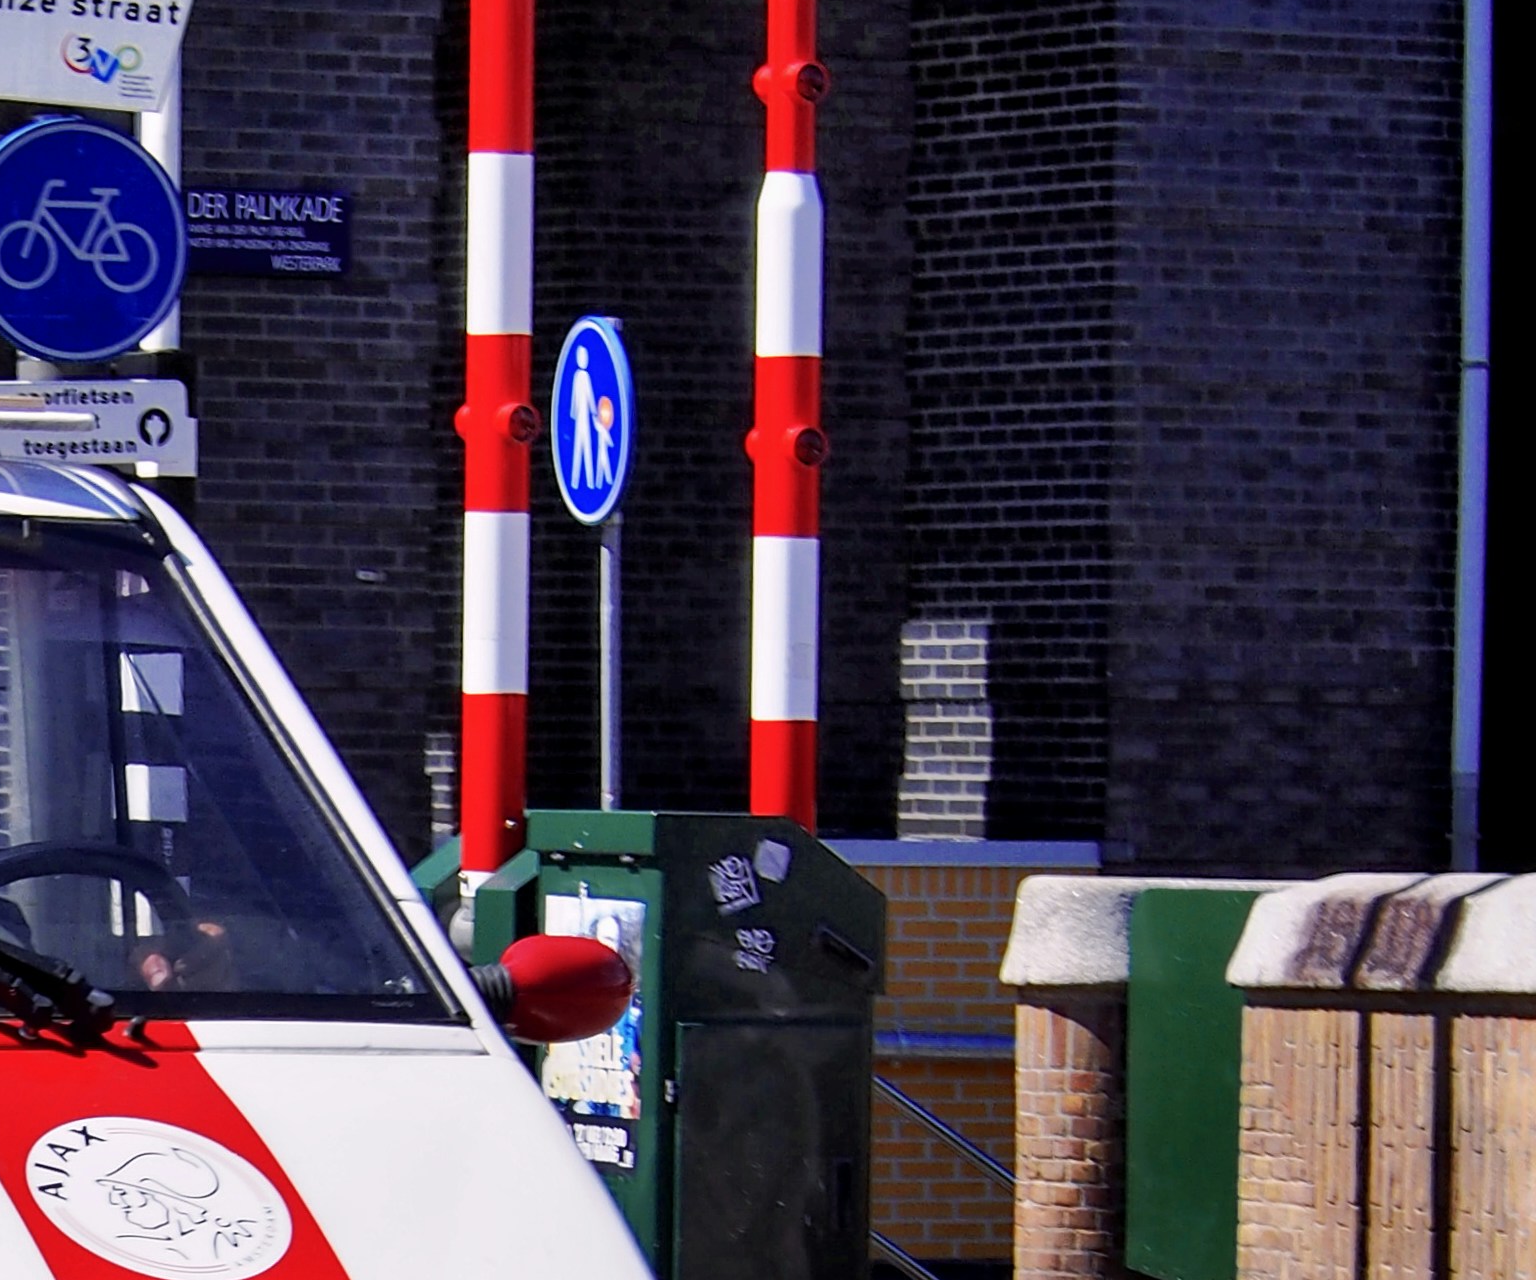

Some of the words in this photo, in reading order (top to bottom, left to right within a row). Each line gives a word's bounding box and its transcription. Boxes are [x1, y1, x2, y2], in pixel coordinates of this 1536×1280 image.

[187, 192, 229, 219] DER
[234, 193, 344, 223] PALMKADE
[23, 438, 138, 459] toegestaan
[33, 1125, 108, 1201] AJAX
